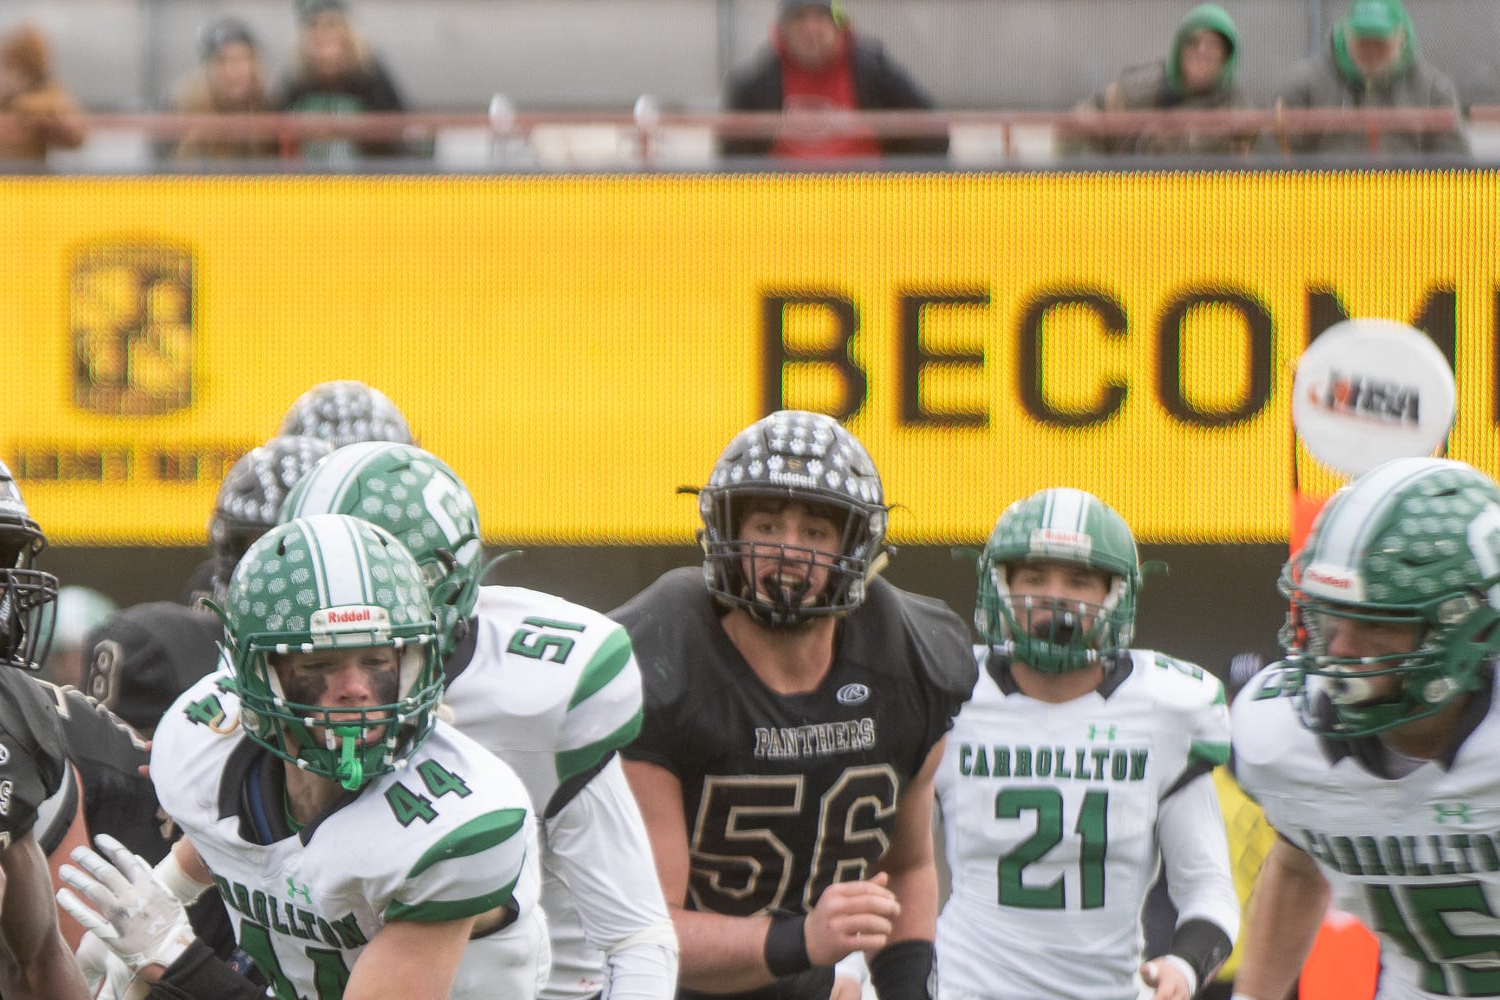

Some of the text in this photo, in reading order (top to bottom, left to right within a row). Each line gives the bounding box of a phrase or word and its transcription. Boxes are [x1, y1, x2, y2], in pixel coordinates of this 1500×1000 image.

[328, 609, 370, 624] Riddell
[505, 615, 588, 665] 51
[753, 718, 876, 760] PANTHERS
[958, 743, 1149, 782] CARROLLTON
[384, 758, 474, 829] 44
[688, 763, 899, 918] 56
[994, 784, 1110, 911] 21
